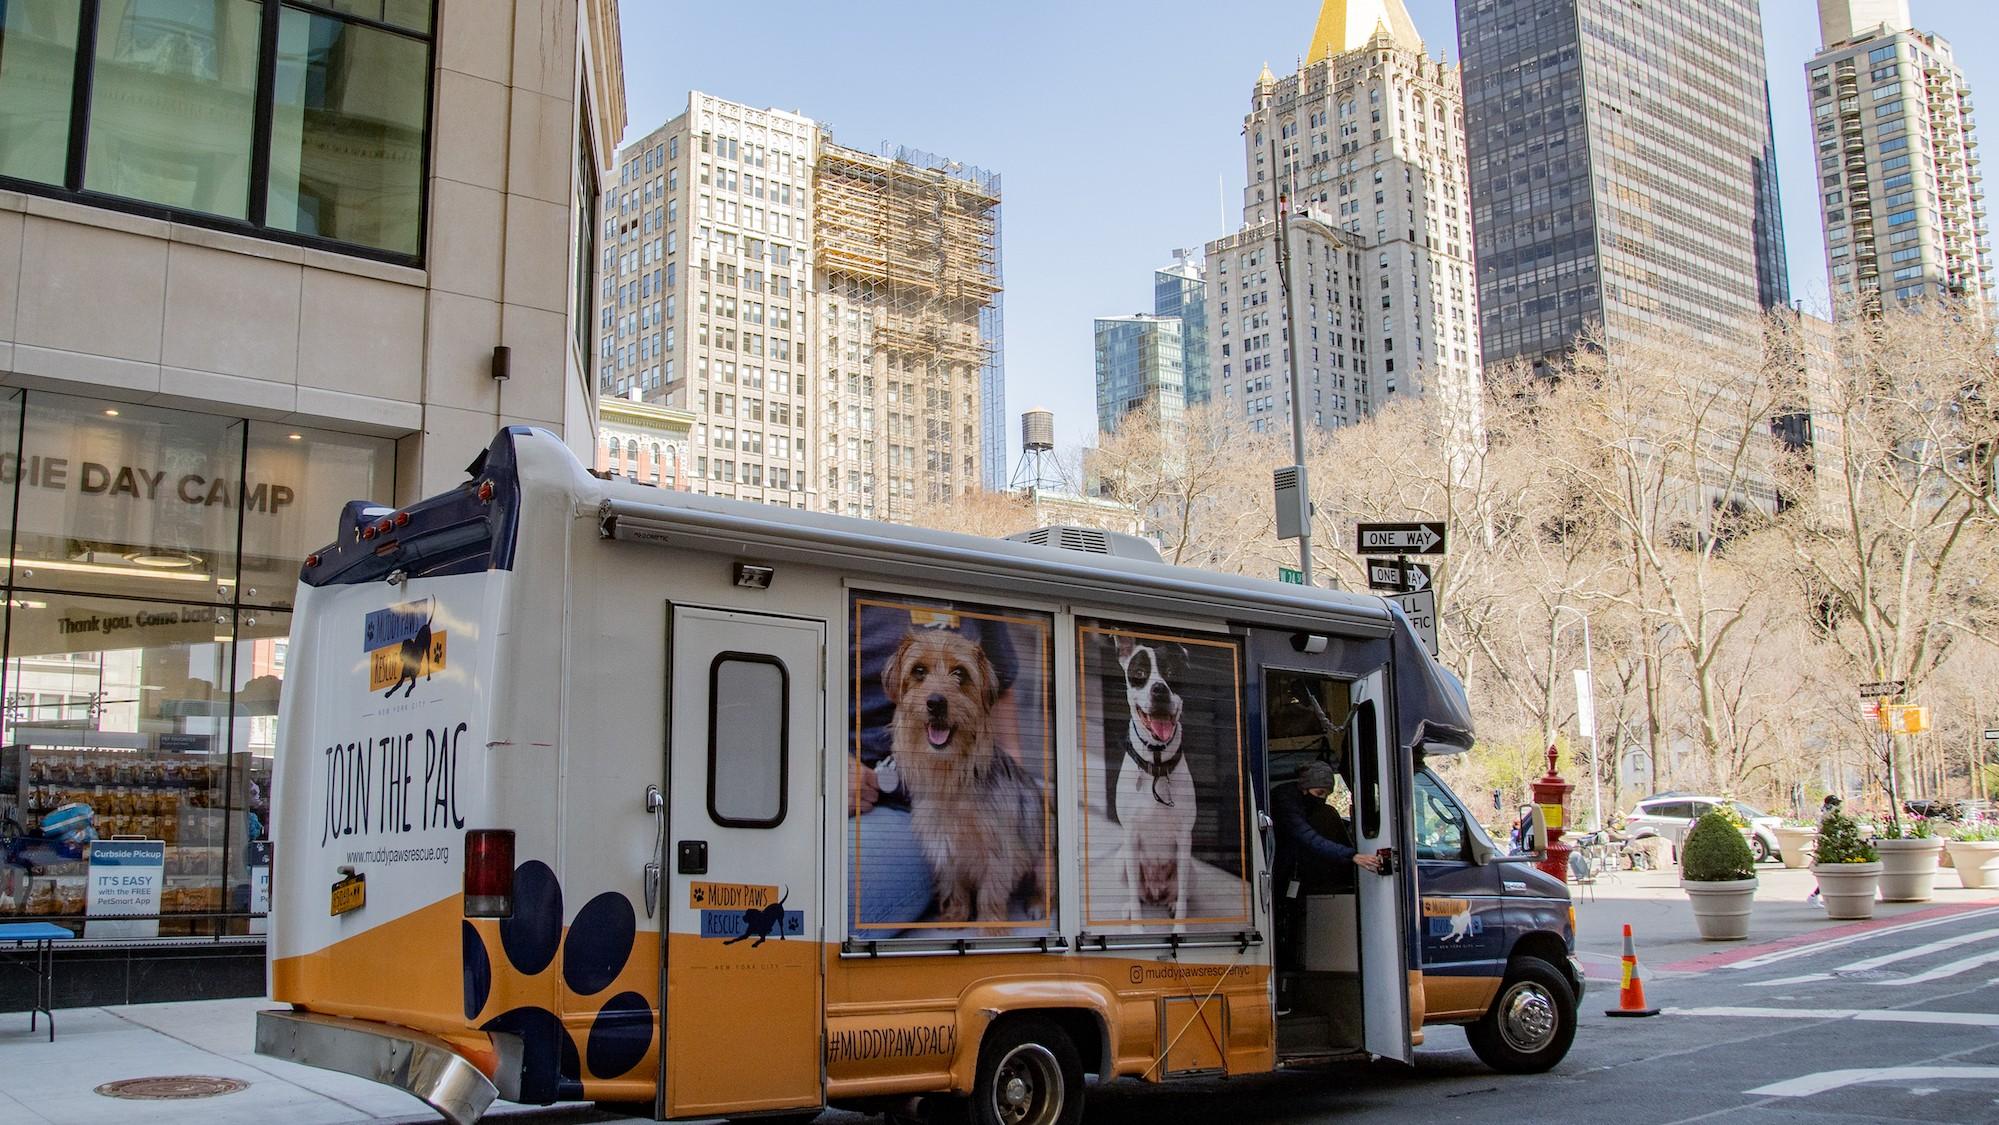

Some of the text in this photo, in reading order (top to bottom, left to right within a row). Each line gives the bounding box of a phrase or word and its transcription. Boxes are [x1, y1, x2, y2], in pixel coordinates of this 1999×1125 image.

[81, 462, 167, 500] DAY
[177, 474, 295, 514] CAMP
[1369, 532, 1433, 545] ONE WAY
[1377, 568, 1397, 582] ONE
[1402, 597, 1422, 614] LL
[58, 616, 100, 634] Thank
[102, 616, 133, 635] you.
[136, 610, 177, 628] Come
[376, 612, 400, 643] MUDDY
[374, 652, 399, 684] RESCUE
[322, 722, 467, 848] JOIN THE PAC
[94, 850, 161, 859] Curbside Pickup
[346, 847, 449, 866] www.muddypawsrescue.org
[98, 876, 152, 886] IT'S EASY
[97, 897, 151, 905] PetSmart App
[708, 885, 768, 907] MUDDY PAWS
[708, 912, 741, 934] RESCUE
[1146, 964, 1250, 981] muddypawsrescuenyc
[829, 1024, 956, 1063] #MUDDYPAWSPACK
